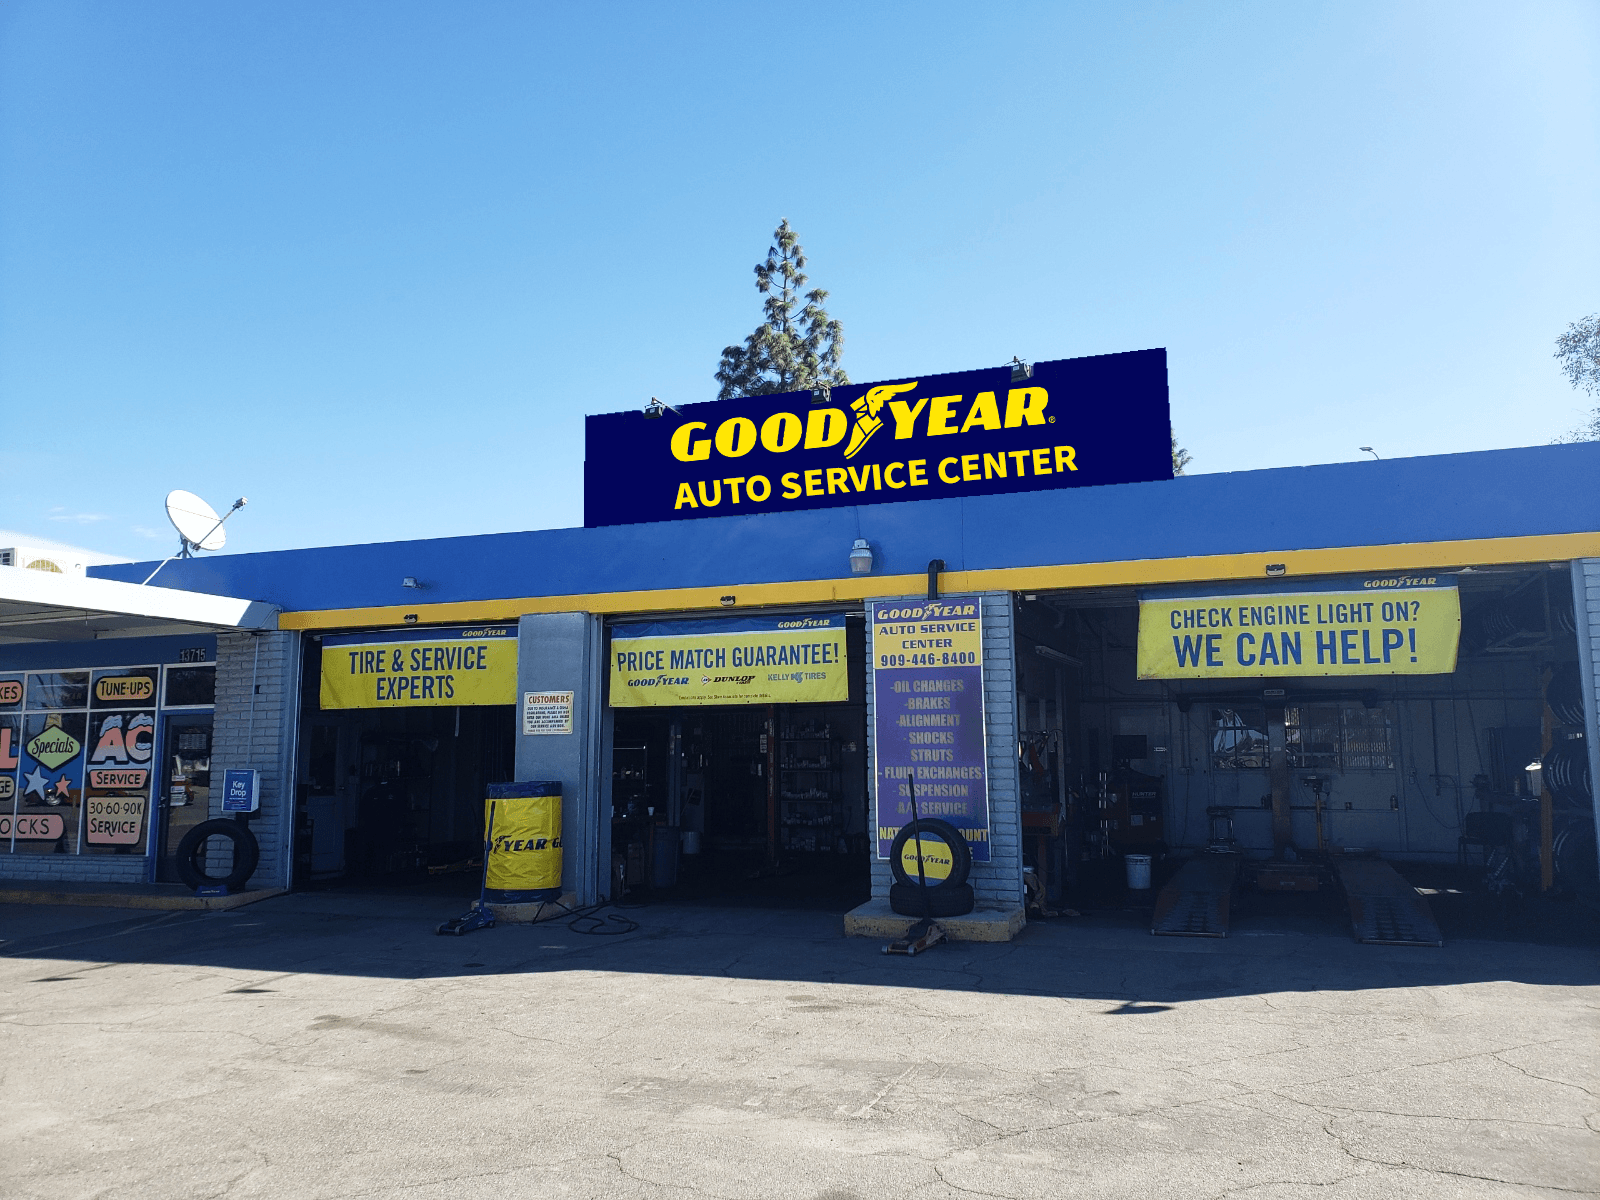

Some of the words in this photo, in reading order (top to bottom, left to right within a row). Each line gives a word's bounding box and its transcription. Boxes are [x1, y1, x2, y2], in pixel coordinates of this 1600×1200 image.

[674, 475, 772, 510] AUTO
[781, 459, 928, 499] SERVICE
[938, 445, 1078, 485] CENTER
[1363, 576, 1437, 588] GOODYEAR
[877, 603, 975, 621] GOODYEAR
[1170, 607, 1233, 629] CHECK
[1239, 604, 1310, 627] ENGINE
[1317, 602, 1374, 624] LIGHT
[1381, 600, 1420, 623] ON?
[777, 618, 830, 629] GOODYEAR
[879, 625, 916, 635] AUTO
[920, 622, 976, 634] SERVICE
[462, 627, 507, 638] GOODYEAR
[902, 638, 953, 649] CENTER
[1172, 634, 1224, 668] WE
[1236, 631, 1301, 667] CAN
[1315, 627, 1418, 665] HELP!
[349, 650, 386, 675] TIRE
[391, 649, 404, 672] &
[410, 646, 488, 672] SERVICE
[617, 650, 665, 672] PRICE
[670, 648, 726, 670] MATCH
[732, 642, 839, 669] GUARANTEE!
[880, 651, 976, 667] 909-446-8400
[628, 674, 689, 687] GOODYEAR
[713, 675, 756, 683] DUNLOP
[767, 673, 790, 681] KELLY
[804, 672, 827, 680] TIRES
[376, 674, 455, 701] EXPERTS
[913, 679, 965, 693] CHANGES
[528, 695, 570, 704] CUSTOMERS
[90, 713, 153, 765] AC
[32, 737, 75, 758] Specials
[910, 749, 954, 762] STRUTS
[96, 772, 141, 785] SERVICE
[917, 766, 983, 780] EXCHANGES
[230, 788, 247, 797] Drop
[232, 781, 246, 790] Key
[921, 801, 968, 815] SERVICE
[90, 817, 136, 837] SERVICE
[880, 826, 902, 840] NAT
